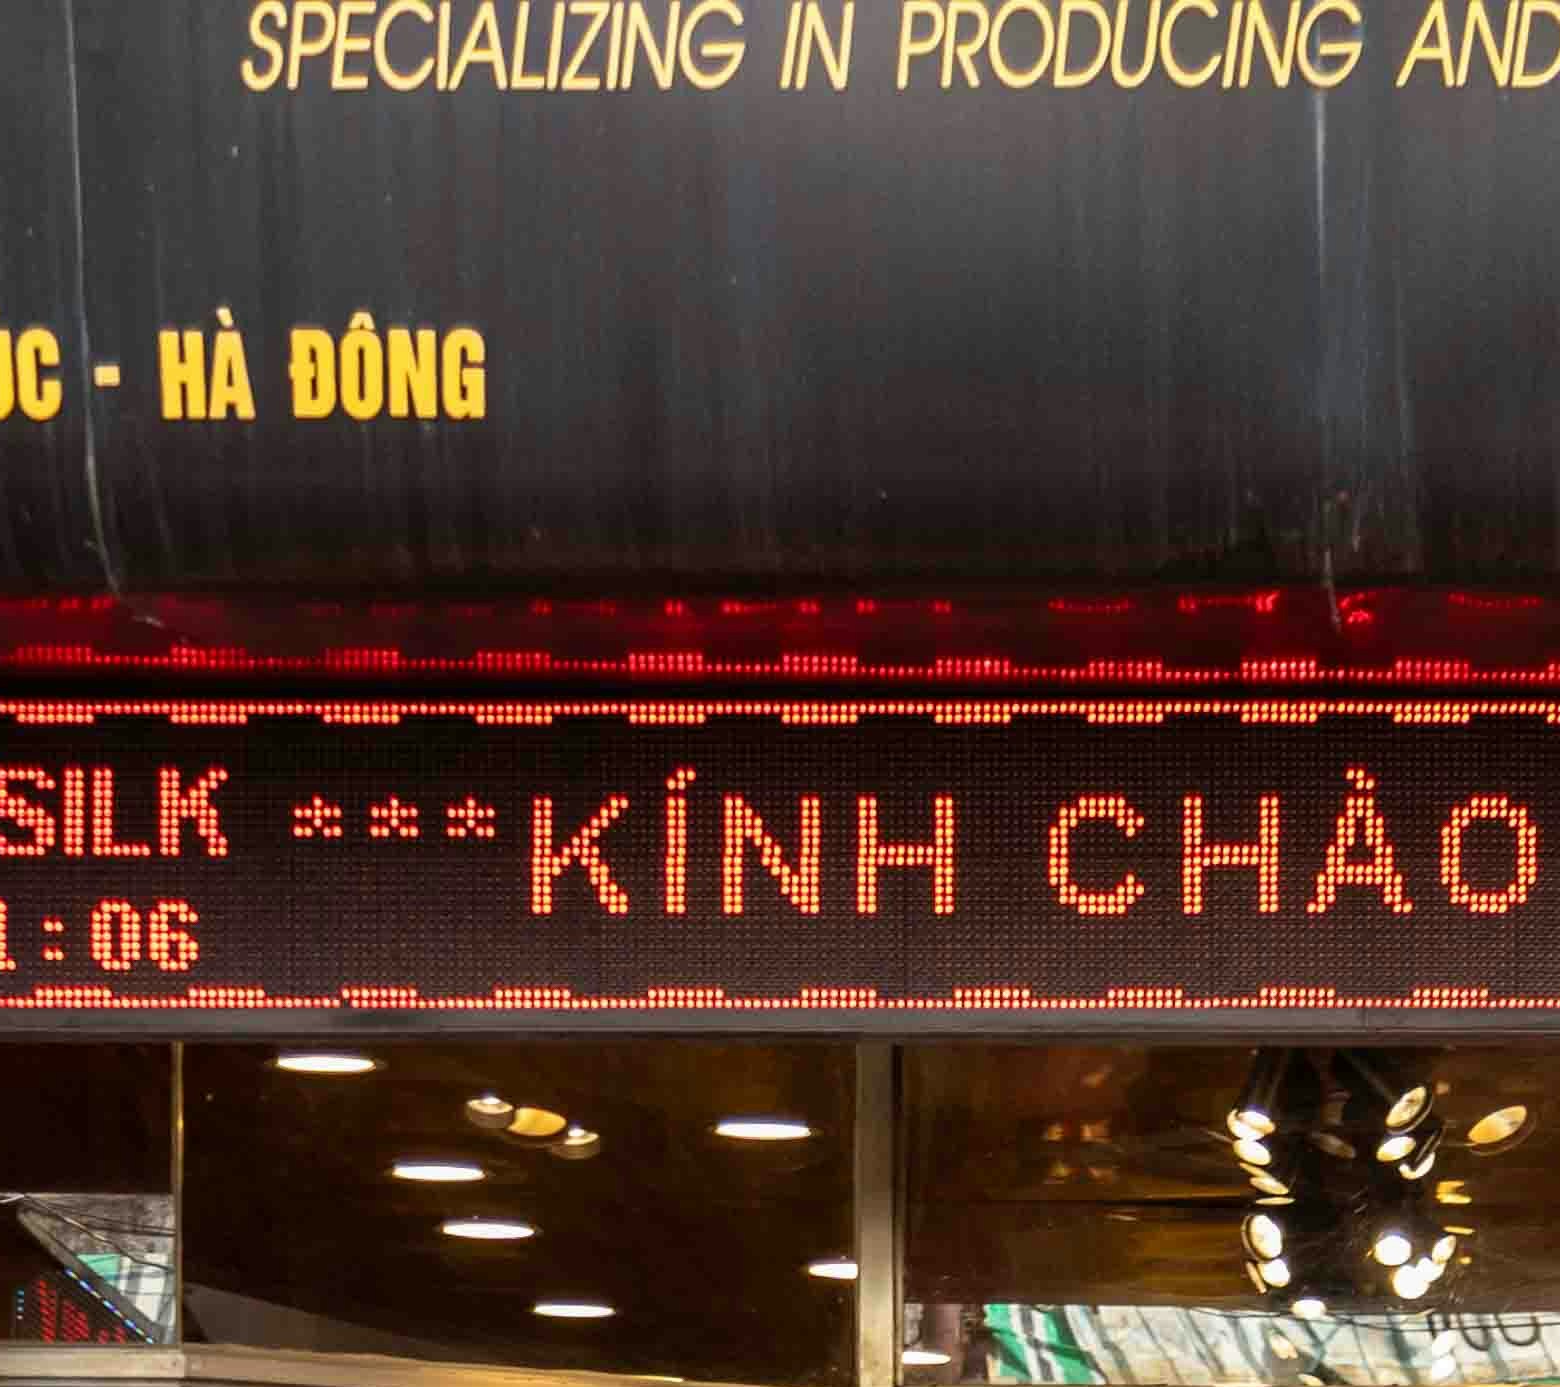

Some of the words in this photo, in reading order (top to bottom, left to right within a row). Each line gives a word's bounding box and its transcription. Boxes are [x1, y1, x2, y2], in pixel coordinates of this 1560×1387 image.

[240, 0, 747, 92] SPECIALIZING
[778, 0, 857, 92] IN
[895, 0, 1364, 91] PRODUCING
[158, 306, 256, 420] HÀ
[288, 310, 487, 421] ĐÔNG
[1047, 768, 1538, 916] CHÀO
